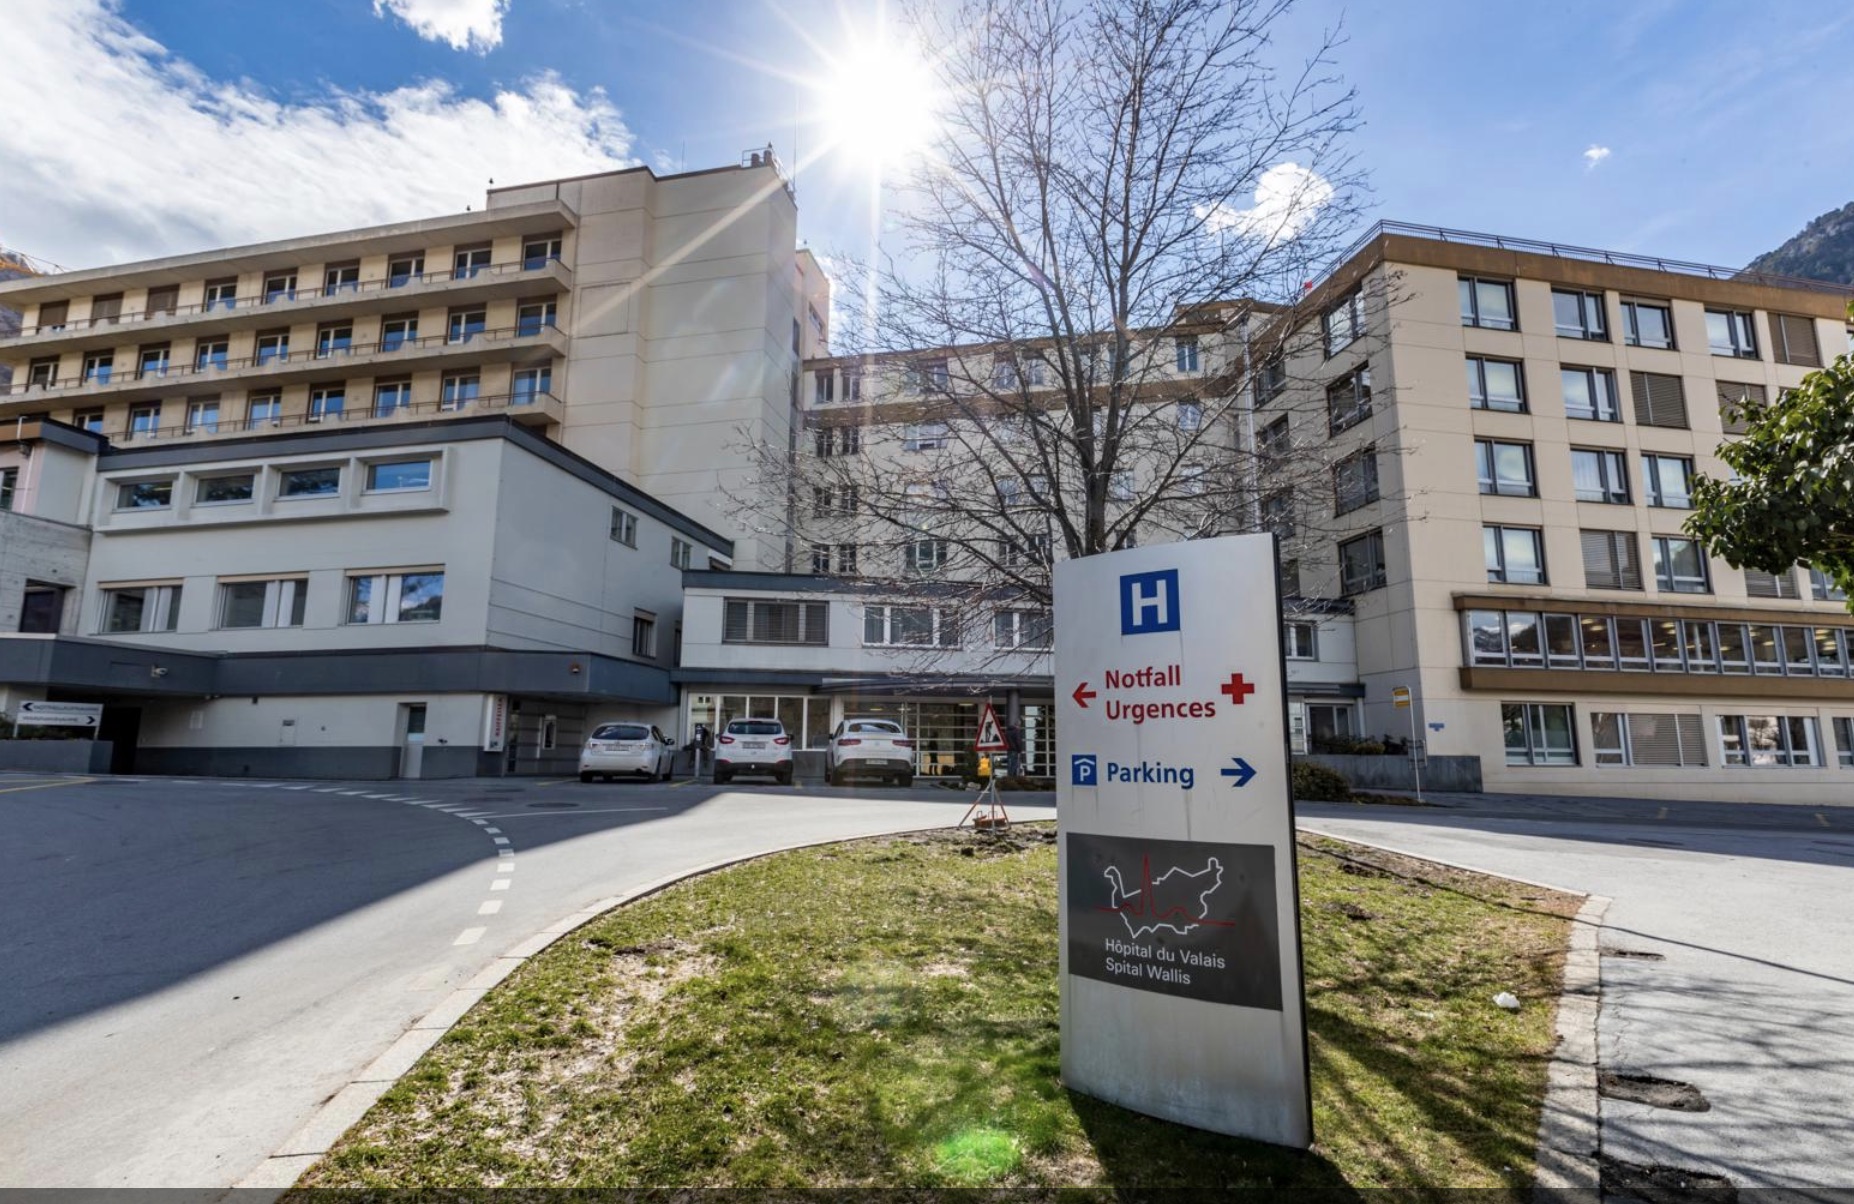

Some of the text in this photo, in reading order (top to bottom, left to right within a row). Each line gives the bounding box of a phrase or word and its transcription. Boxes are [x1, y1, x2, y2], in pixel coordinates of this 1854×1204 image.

[1131, 579, 1168, 626] H
[1105, 664, 1181, 689] Notfall
[1105, 700, 1216, 725] Urgences
[1079, 766, 1091, 782] P
[1107, 762, 1194, 790] Parking
[1105, 938, 1226, 969] Hôpital du Valais
[1105, 957, 1191, 985] Spital Wallis
